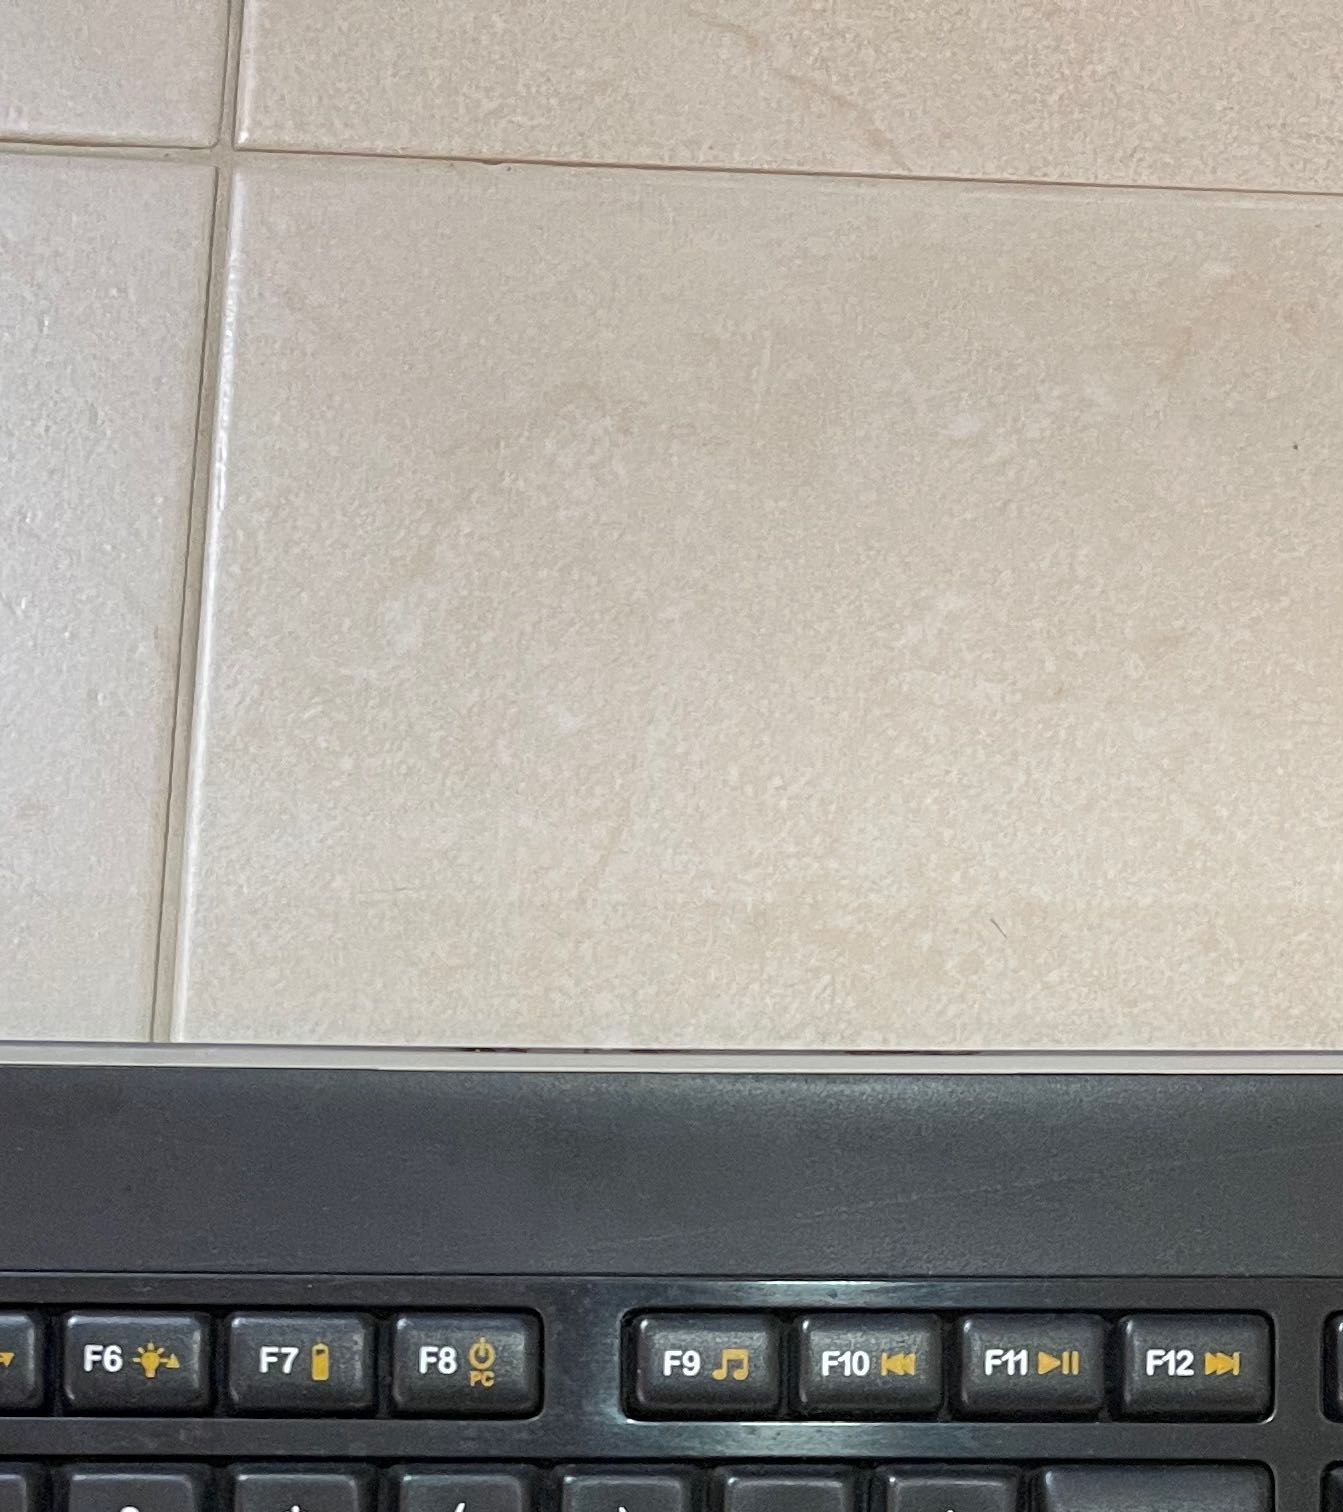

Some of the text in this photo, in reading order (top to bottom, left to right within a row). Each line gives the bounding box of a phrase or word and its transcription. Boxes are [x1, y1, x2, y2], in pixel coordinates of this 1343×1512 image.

[83, 1344, 123, 1373] F6
[259, 1346, 299, 1374] F7
[419, 1345, 457, 1375] F8
[663, 1349, 701, 1377] F9
[821, 1350, 870, 1377] F10
[984, 1348, 1028, 1376] F11
[1146, 1349, 1195, 1376] F12
[469, 1366, 495, 1387] PC
